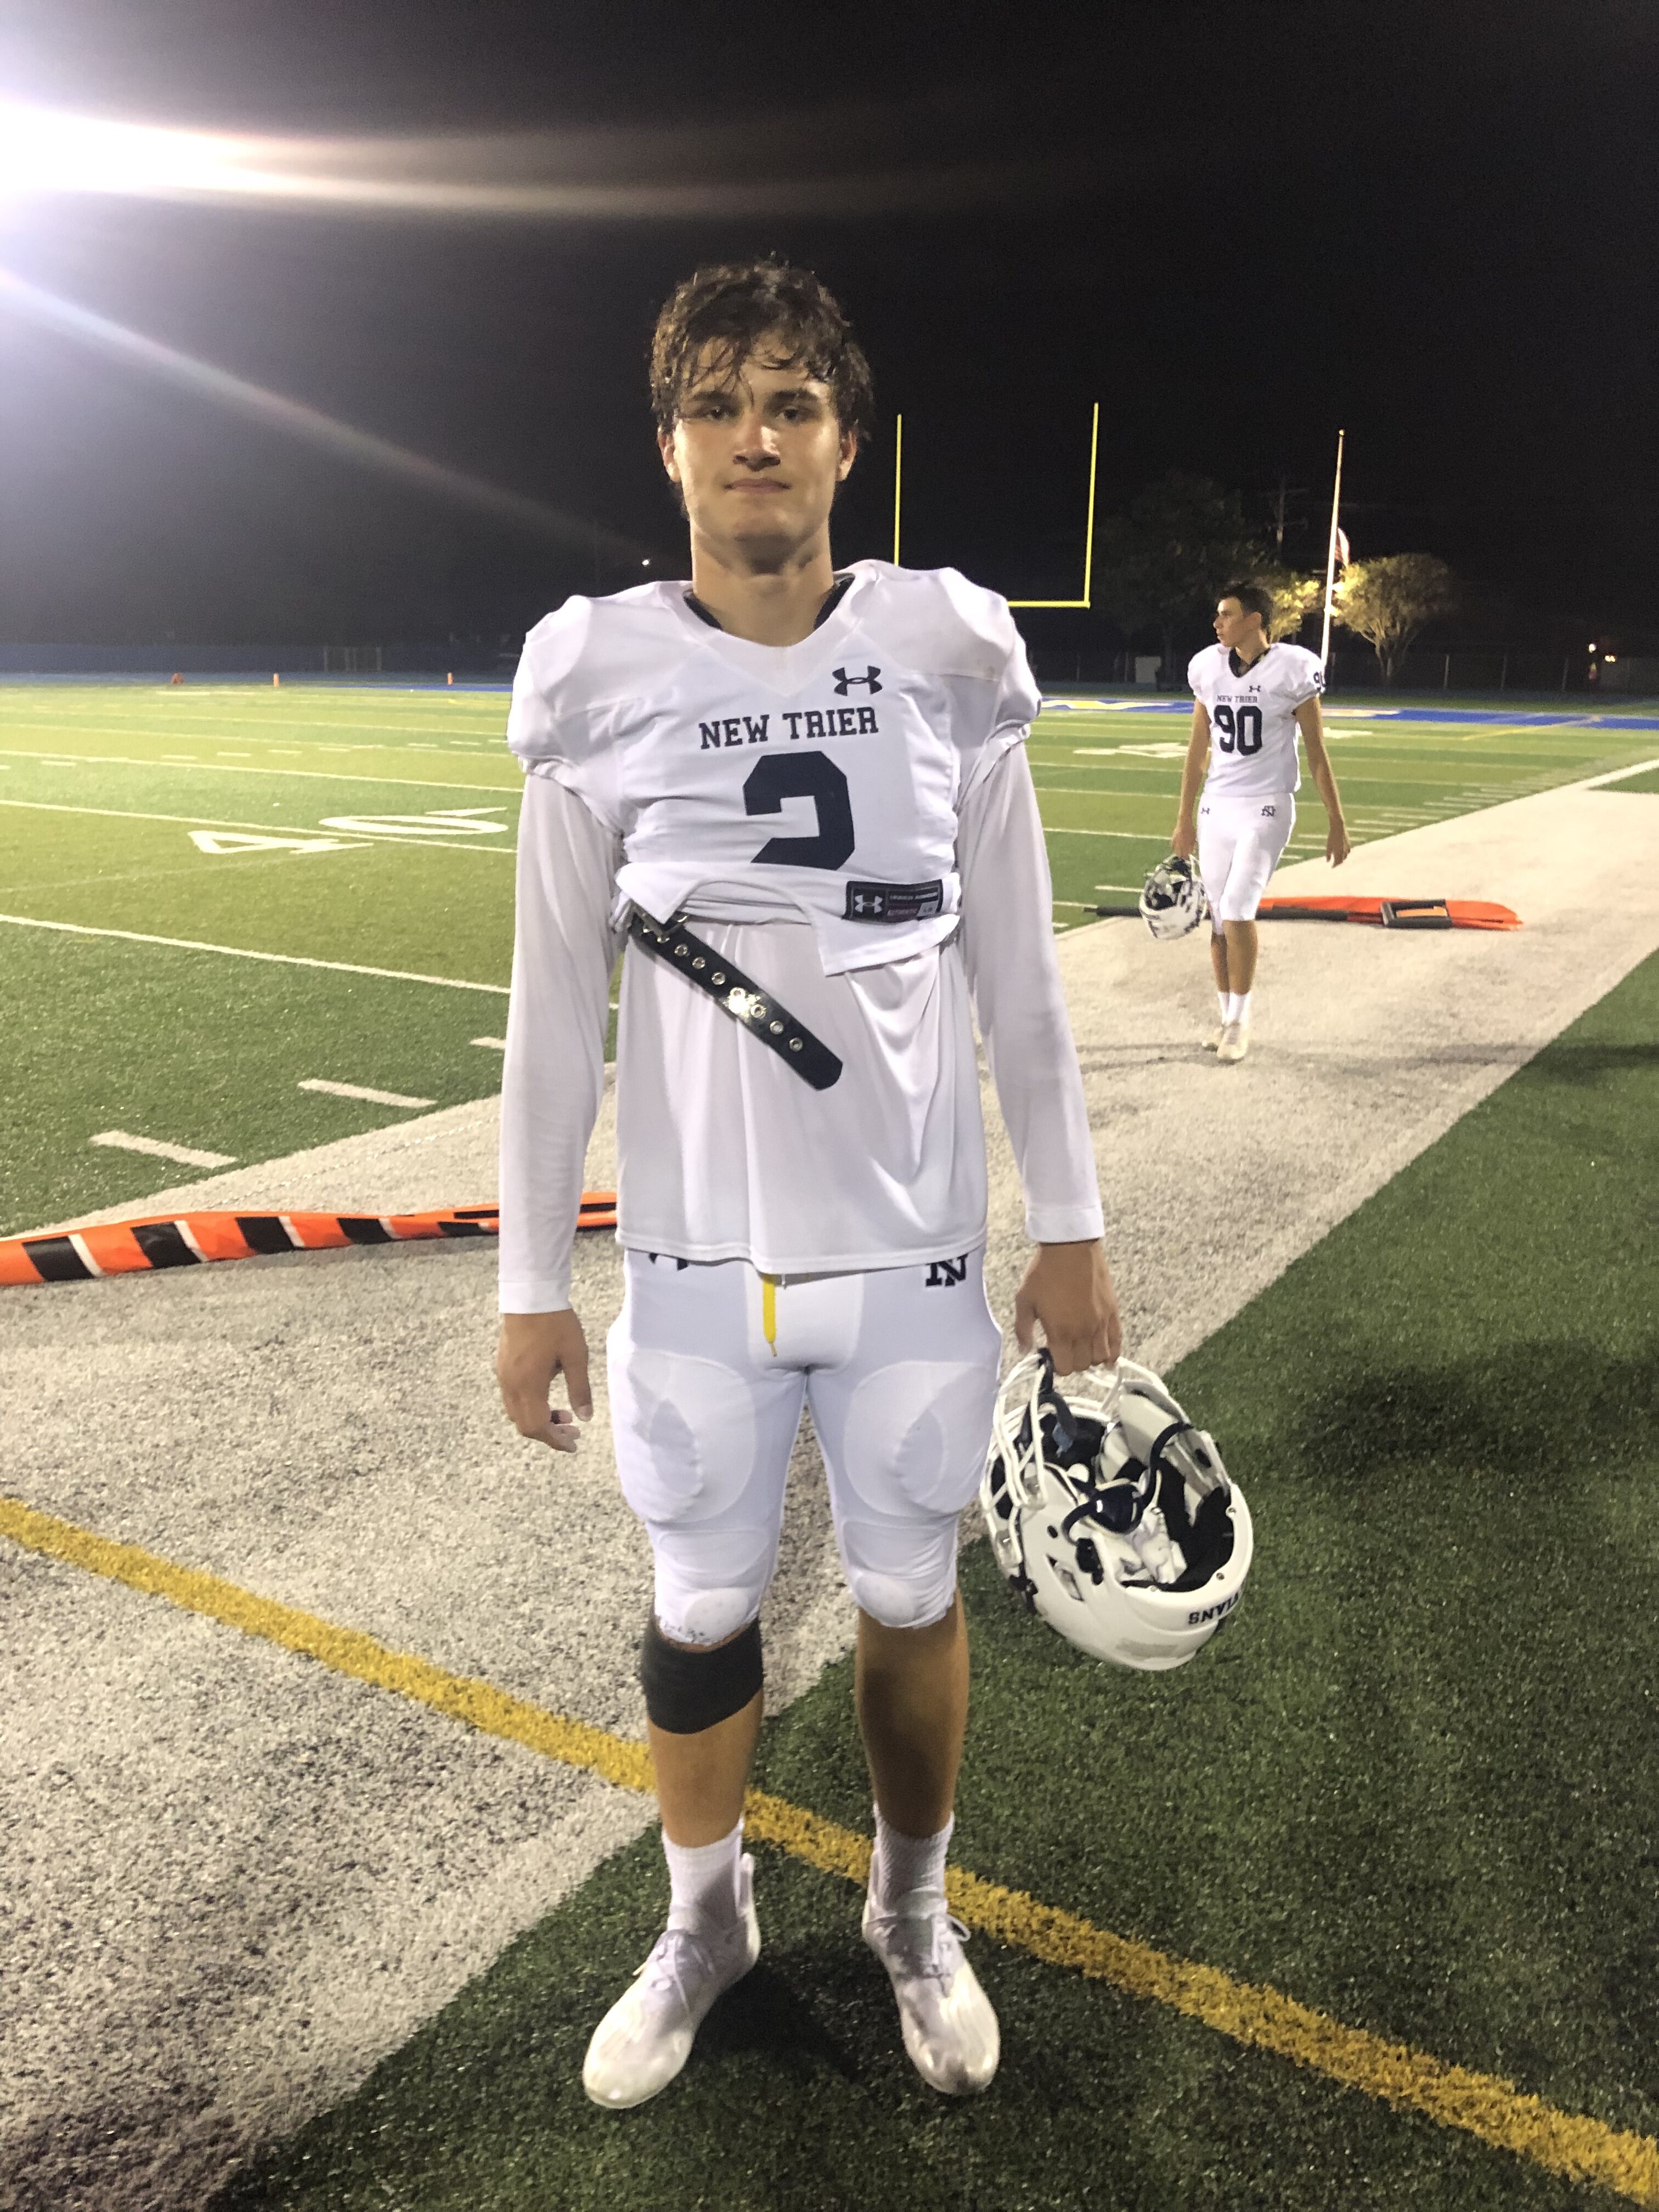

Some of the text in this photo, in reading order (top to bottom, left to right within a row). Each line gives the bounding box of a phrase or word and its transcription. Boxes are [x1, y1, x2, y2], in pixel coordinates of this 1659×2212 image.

[699, 707, 879, 749] NEW TRIER
[1213, 704, 1262, 756] 90
[742, 751, 855, 871] 2
